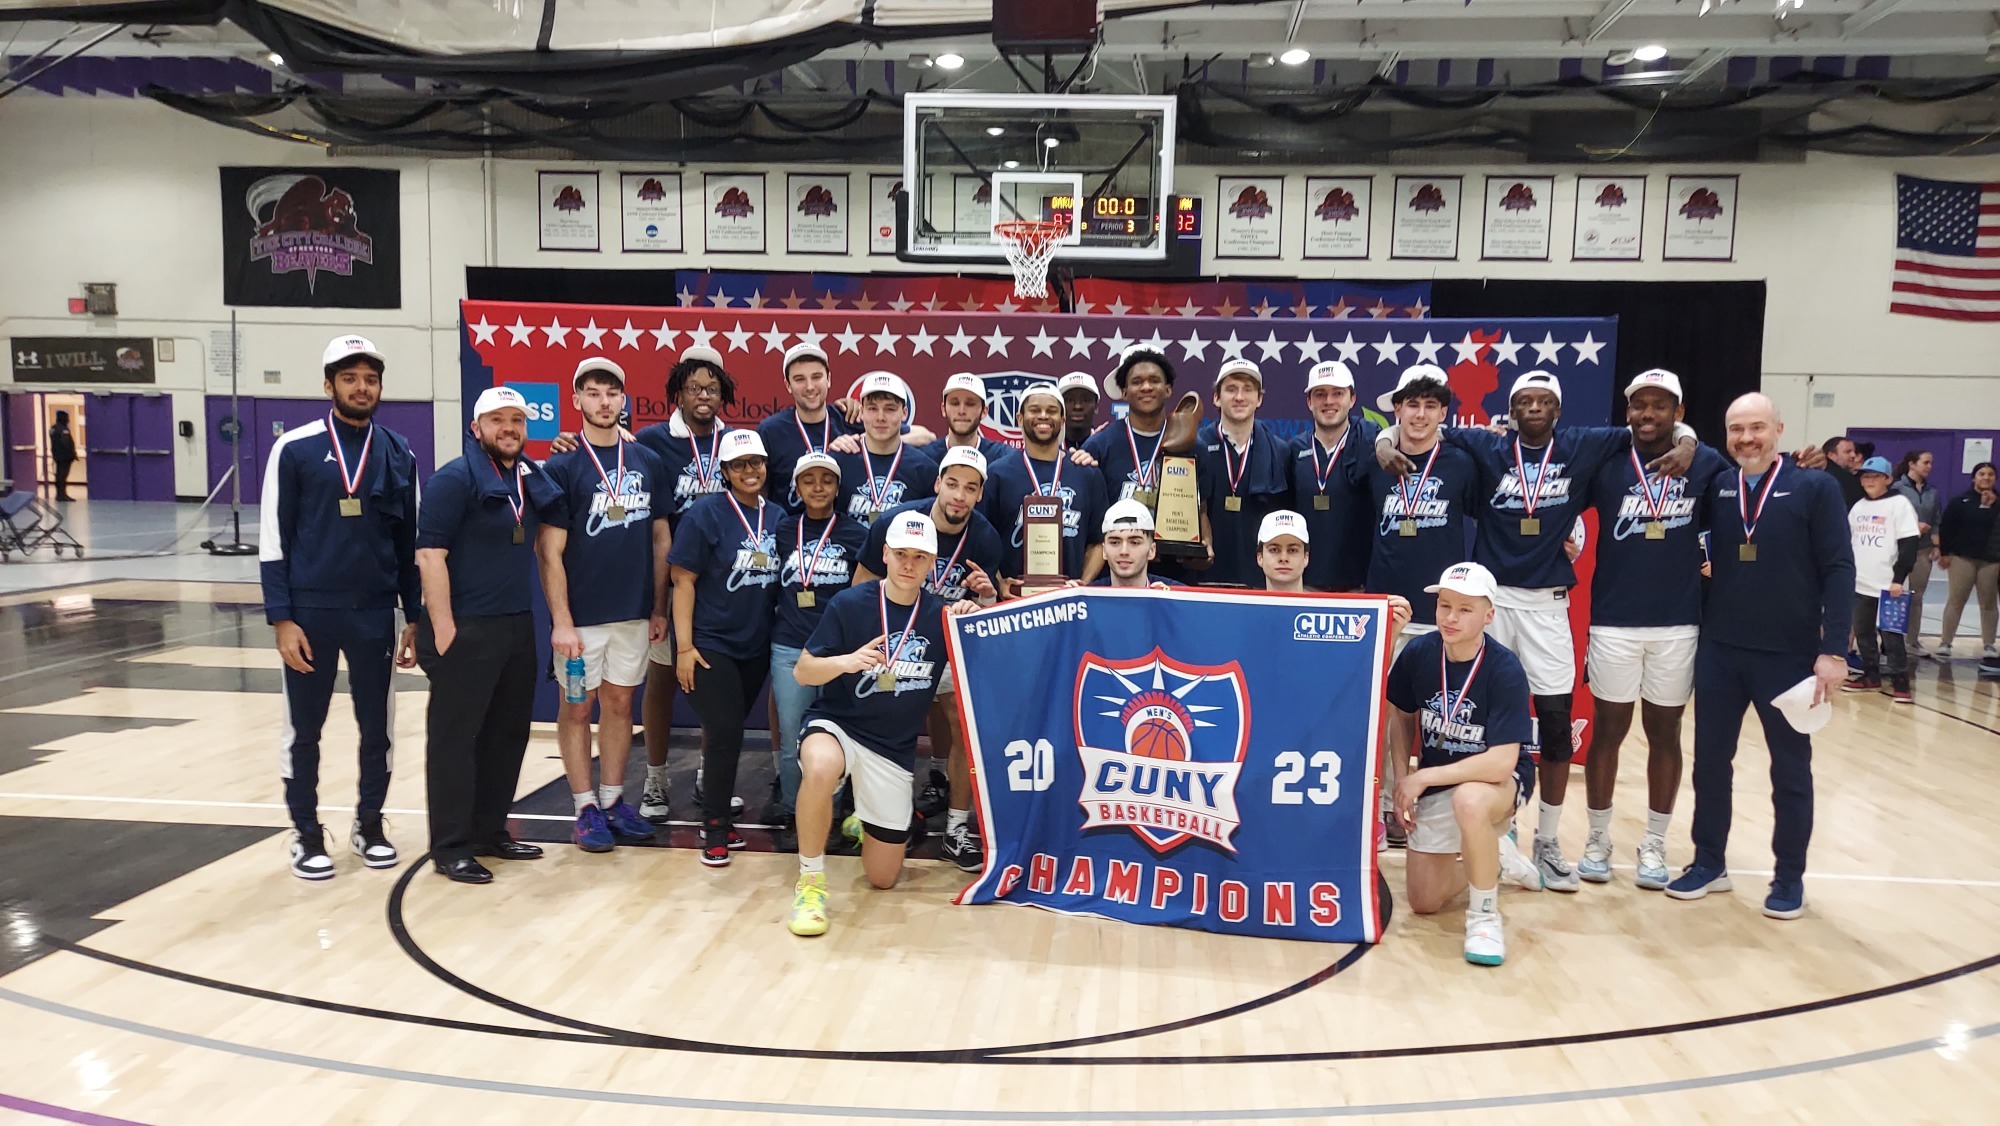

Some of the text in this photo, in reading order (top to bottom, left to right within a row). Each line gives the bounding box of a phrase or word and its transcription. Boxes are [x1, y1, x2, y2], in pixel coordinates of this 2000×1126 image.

[1098, 197, 1135, 215] 00.0
[1100, 221, 1124, 231] PERIOD
[1127, 219, 1135, 232] 3
[964, 601, 1088, 638] #CUNYCHAMPS
[1296, 614, 1371, 637] CUNY
[1147, 708, 1173, 721] MEN'S
[1004, 738, 1342, 805] 20 23
[1093, 759, 1227, 810] CUNY
[1099, 803, 1224, 841] BASKETBALL
[994, 852, 1341, 928] CHAMPIONS
